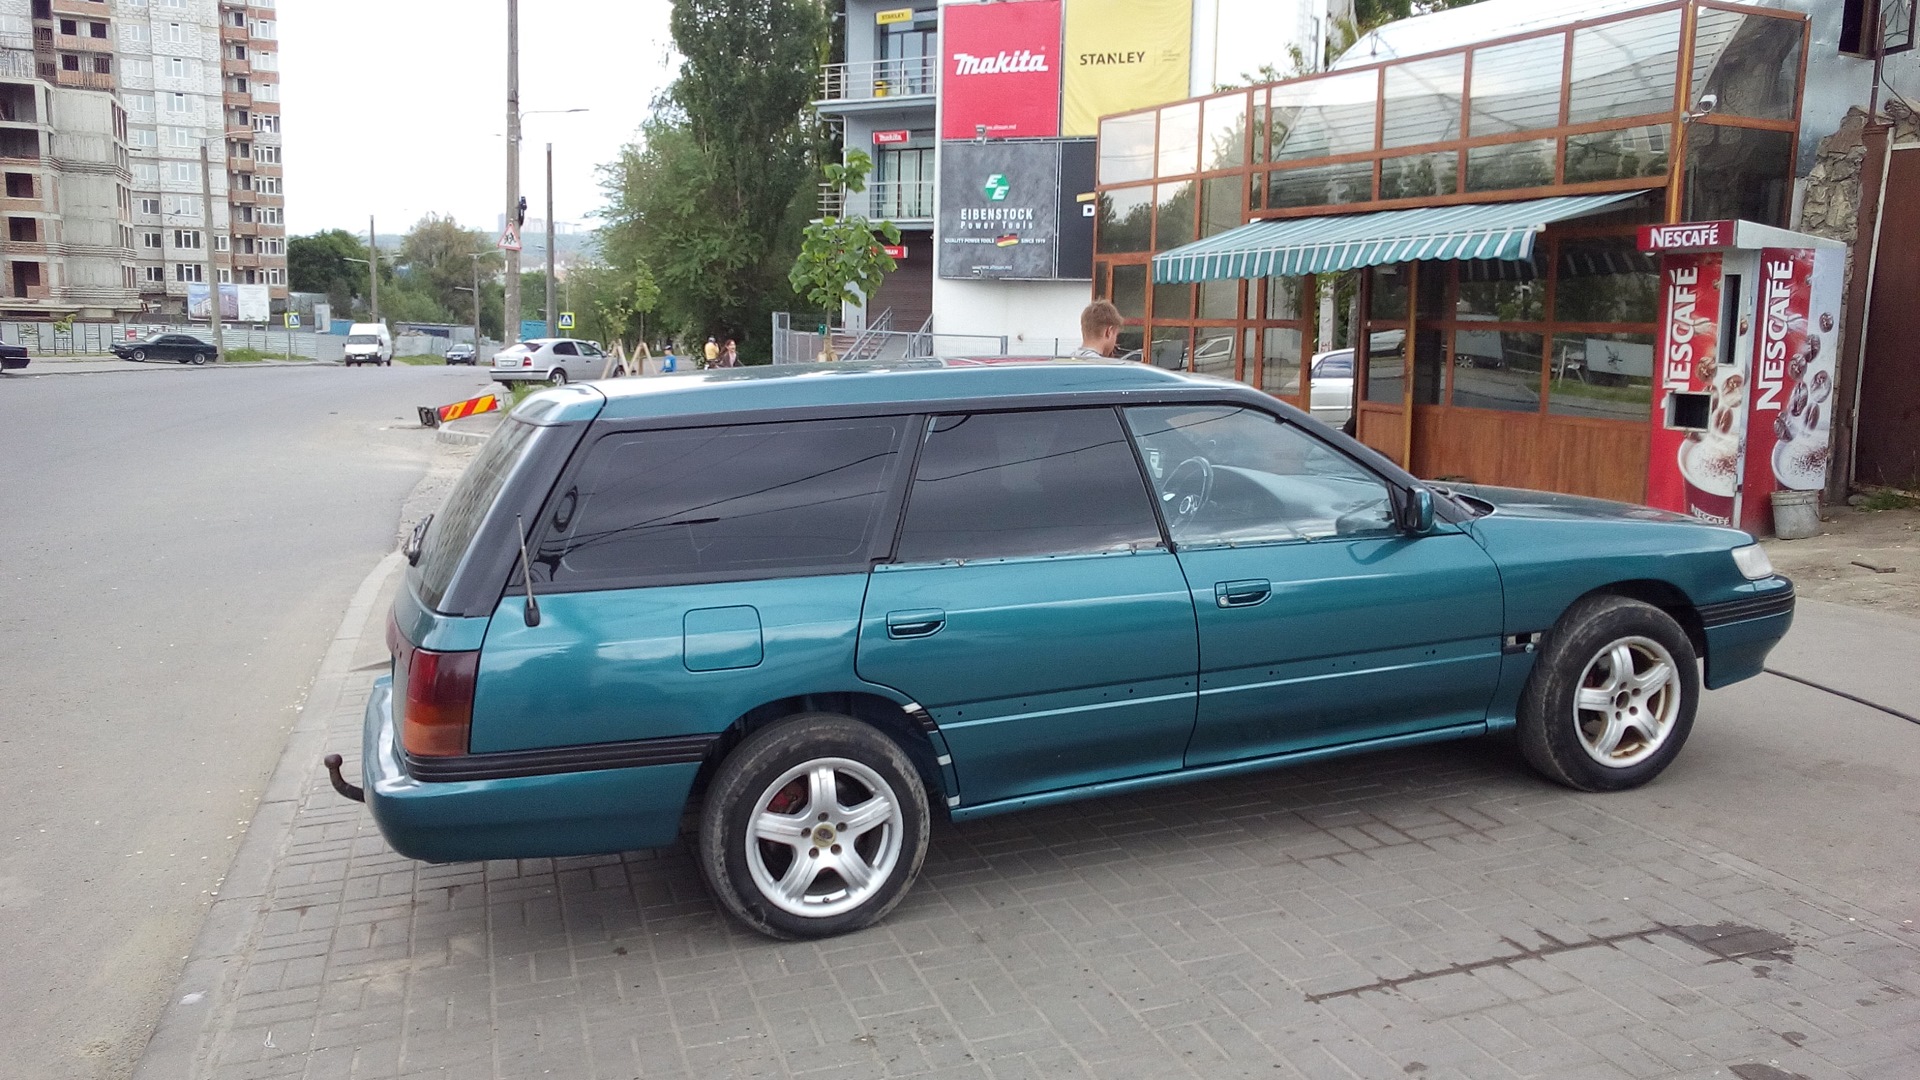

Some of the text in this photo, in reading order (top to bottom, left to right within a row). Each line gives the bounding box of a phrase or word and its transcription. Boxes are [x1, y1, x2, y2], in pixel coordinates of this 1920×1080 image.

[953, 50, 1049, 75] Makita
[1080, 51, 1146, 66] STANLEY
[878, 133, 903, 142] Makita
[960, 208, 1033, 220] EIBENSTOCK
[960, 220, 1033, 230] Power Tools
[1650, 223, 1719, 249] NESCAFÉ
[1756, 260, 1794, 411] NESCAFÉ
